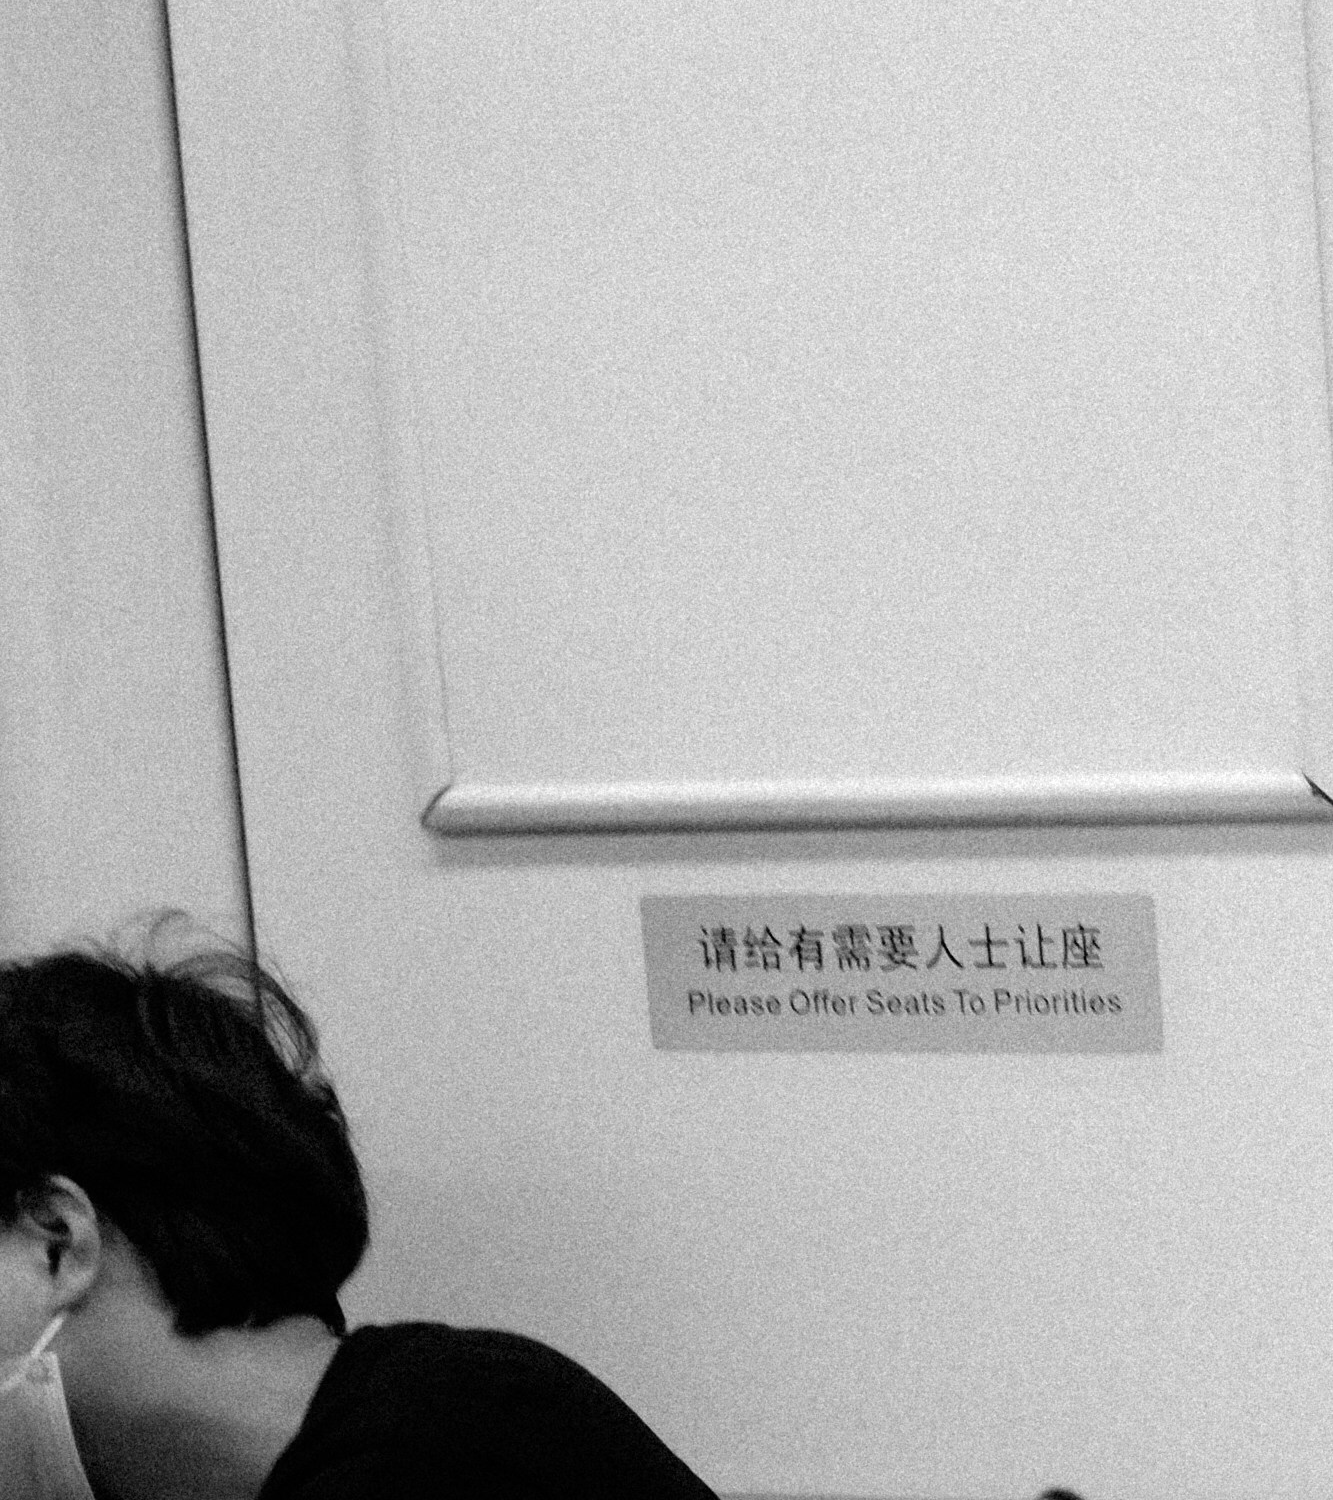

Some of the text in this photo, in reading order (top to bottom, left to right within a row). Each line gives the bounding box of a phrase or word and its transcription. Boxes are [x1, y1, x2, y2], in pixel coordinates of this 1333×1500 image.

[698, 923, 1104, 973] 请给有需要人士让座
[688, 987, 1123, 1016] Please Offer Seats To Priorities
